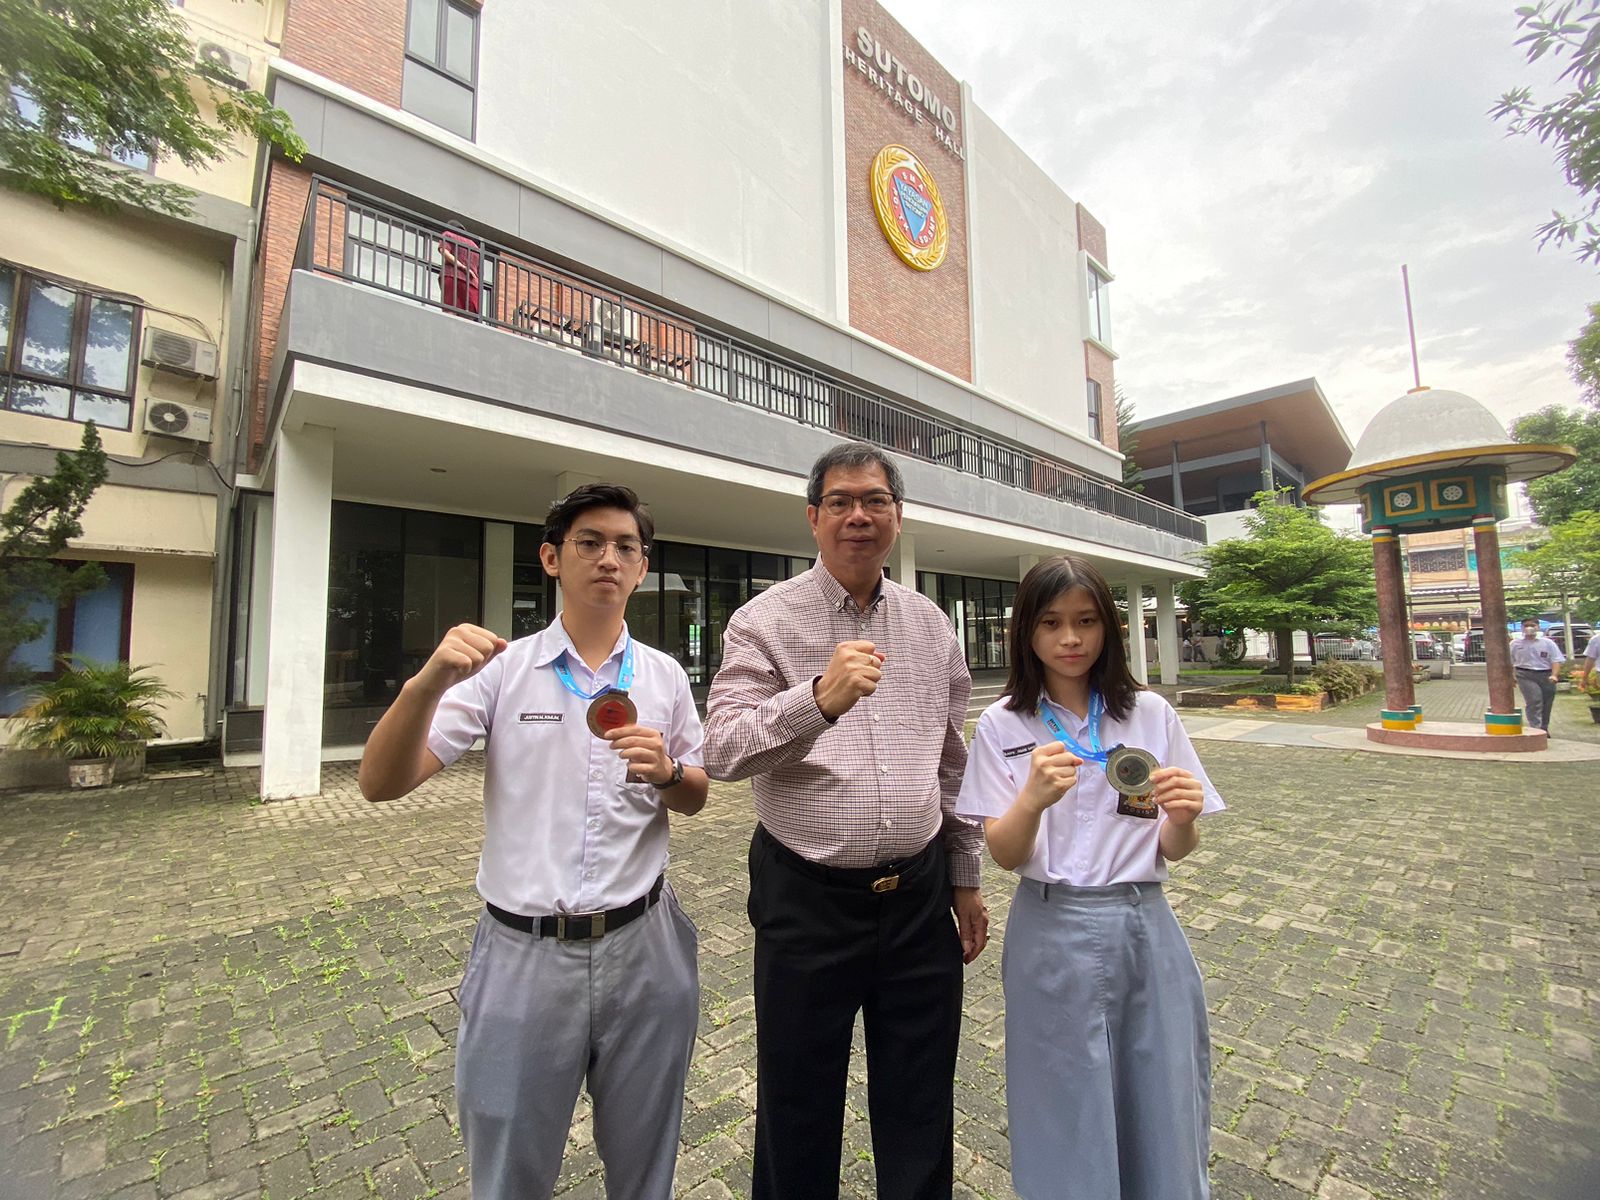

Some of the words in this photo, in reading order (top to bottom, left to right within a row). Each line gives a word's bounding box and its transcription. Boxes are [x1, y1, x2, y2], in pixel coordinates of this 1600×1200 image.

[845, 45, 924, 126] HERITAGE
[935, 125, 965, 161] HALL
[857, 26, 957, 131] SUTOMO
